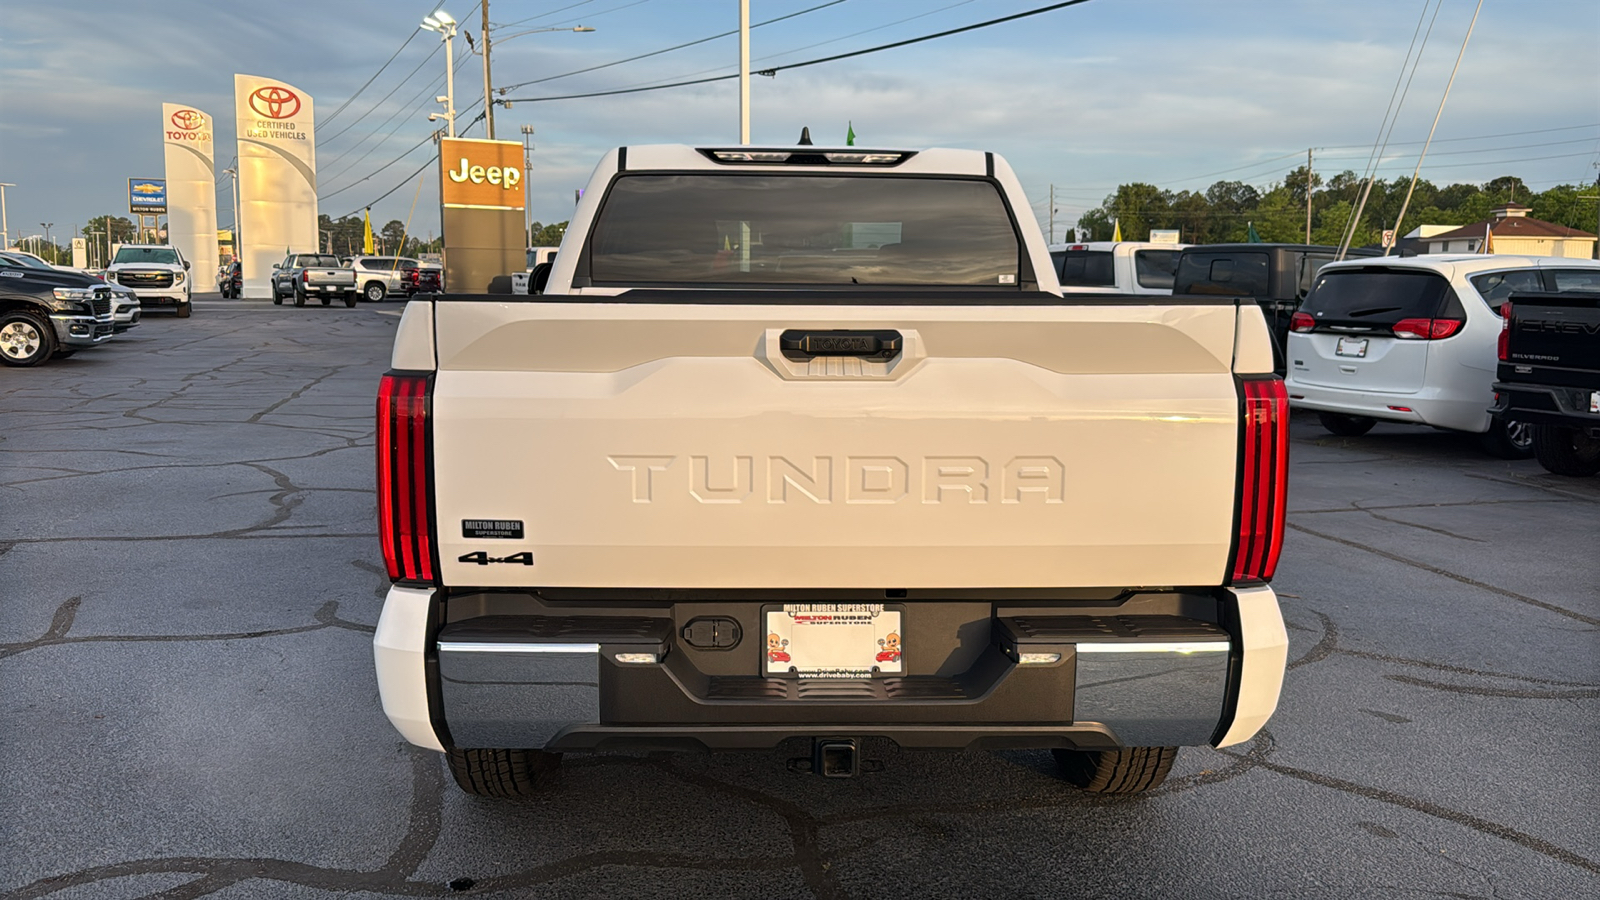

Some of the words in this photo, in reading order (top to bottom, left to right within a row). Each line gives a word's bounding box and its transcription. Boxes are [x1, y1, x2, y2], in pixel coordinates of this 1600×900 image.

[256, 120, 296, 130] CERTIFIED
[166, 131, 211, 142] TOYOTA
[246, 129, 268, 138] USED
[270, 130, 306, 140] VEHICLES
[449, 157, 520, 190] Jeep
[813, 337, 869, 350] TOYOTA
[1512, 353, 1560, 361] SILVERADO
[606, 454, 1066, 505] TUNDRA
[465, 521, 494, 530] MILTON
[494, 521, 521, 531] RUBEN
[783, 603, 811, 612] MILTON
[811, 603, 837, 612] RUBEN
[837, 603, 885, 612] SUPERSTORE
